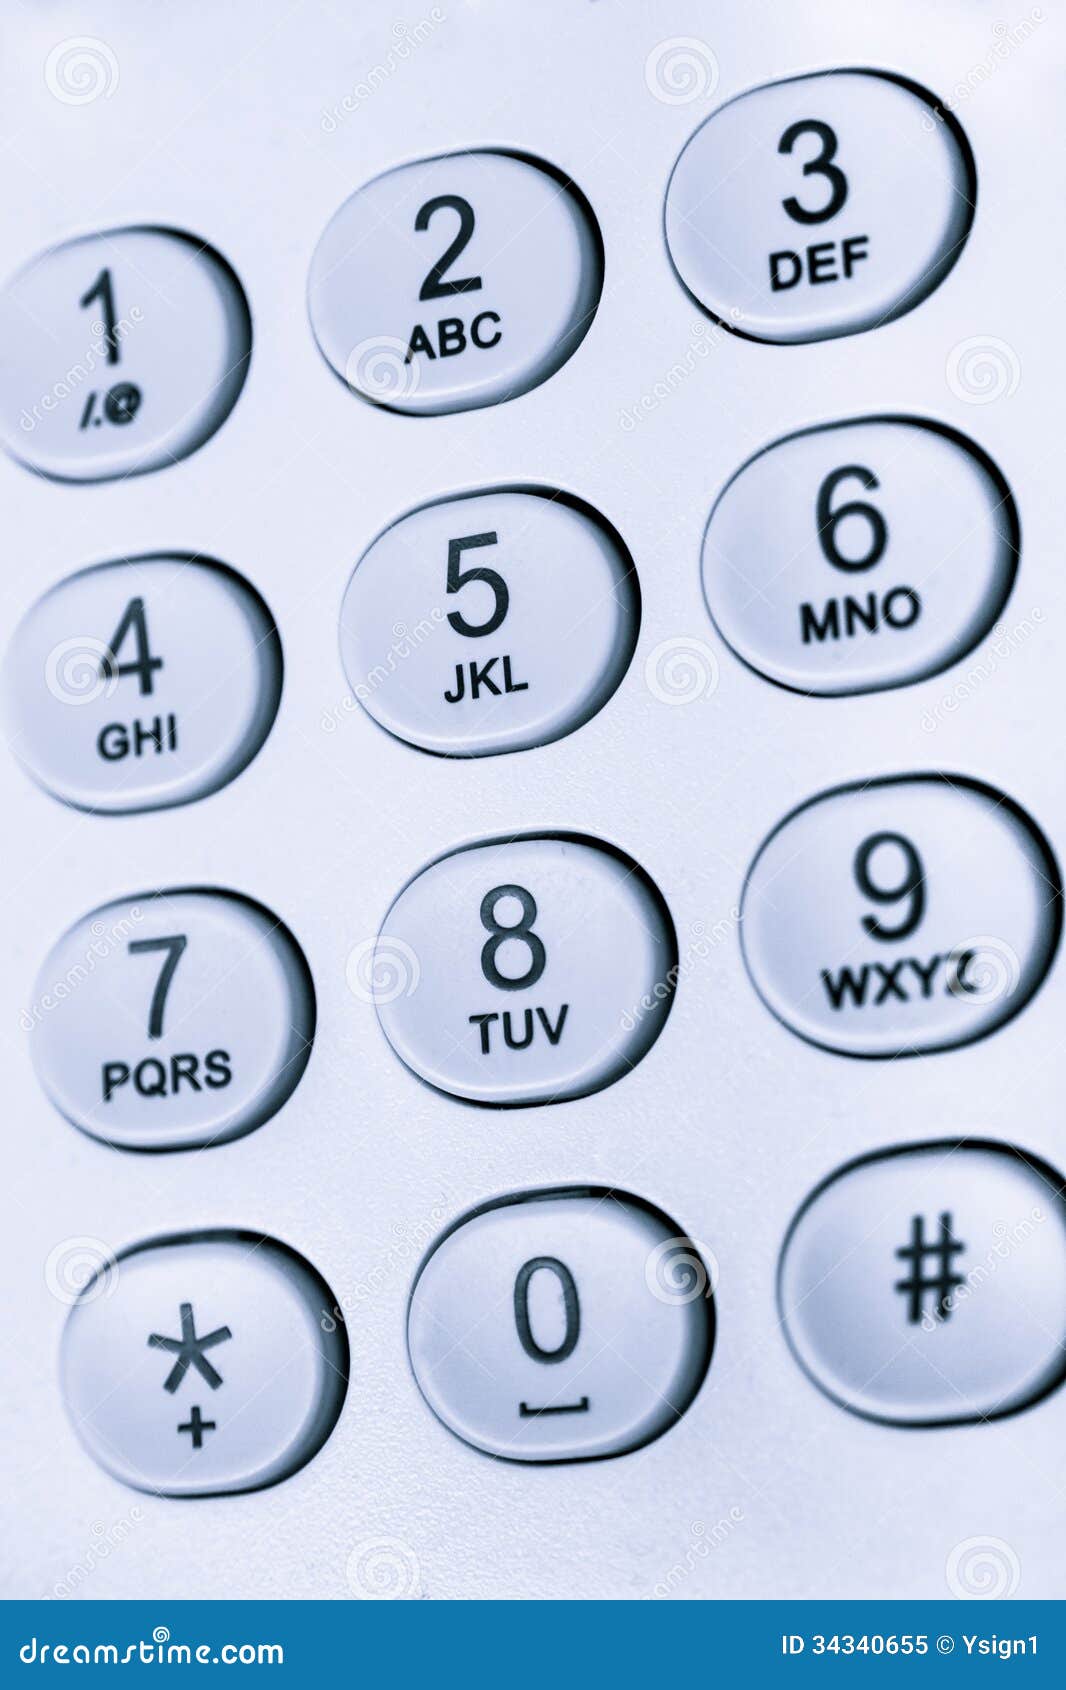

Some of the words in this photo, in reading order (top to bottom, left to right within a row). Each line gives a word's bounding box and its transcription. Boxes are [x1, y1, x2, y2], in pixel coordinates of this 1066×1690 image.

[779, 119, 850, 227] 3
[415, 195, 484, 303] 2
[769, 236, 870, 294] DEF
[81, 268, 122, 367] 1
[404, 311, 503, 366] ABC
[817, 465, 890, 576] 6
[446, 531, 511, 640] 5
[800, 586, 923, 646] MNO
[100, 597, 165, 698] 4
[445, 655, 530, 705] JKL
[97, 714, 179, 764] GHI
[480, 884, 548, 993] 8
[854, 831, 928, 945] 9
[128, 934, 188, 1041] 7
[469, 1005, 570, 1056] TUV
[102, 1049, 233, 1103] PQRS
[514, 1256, 582, 1366] 0
